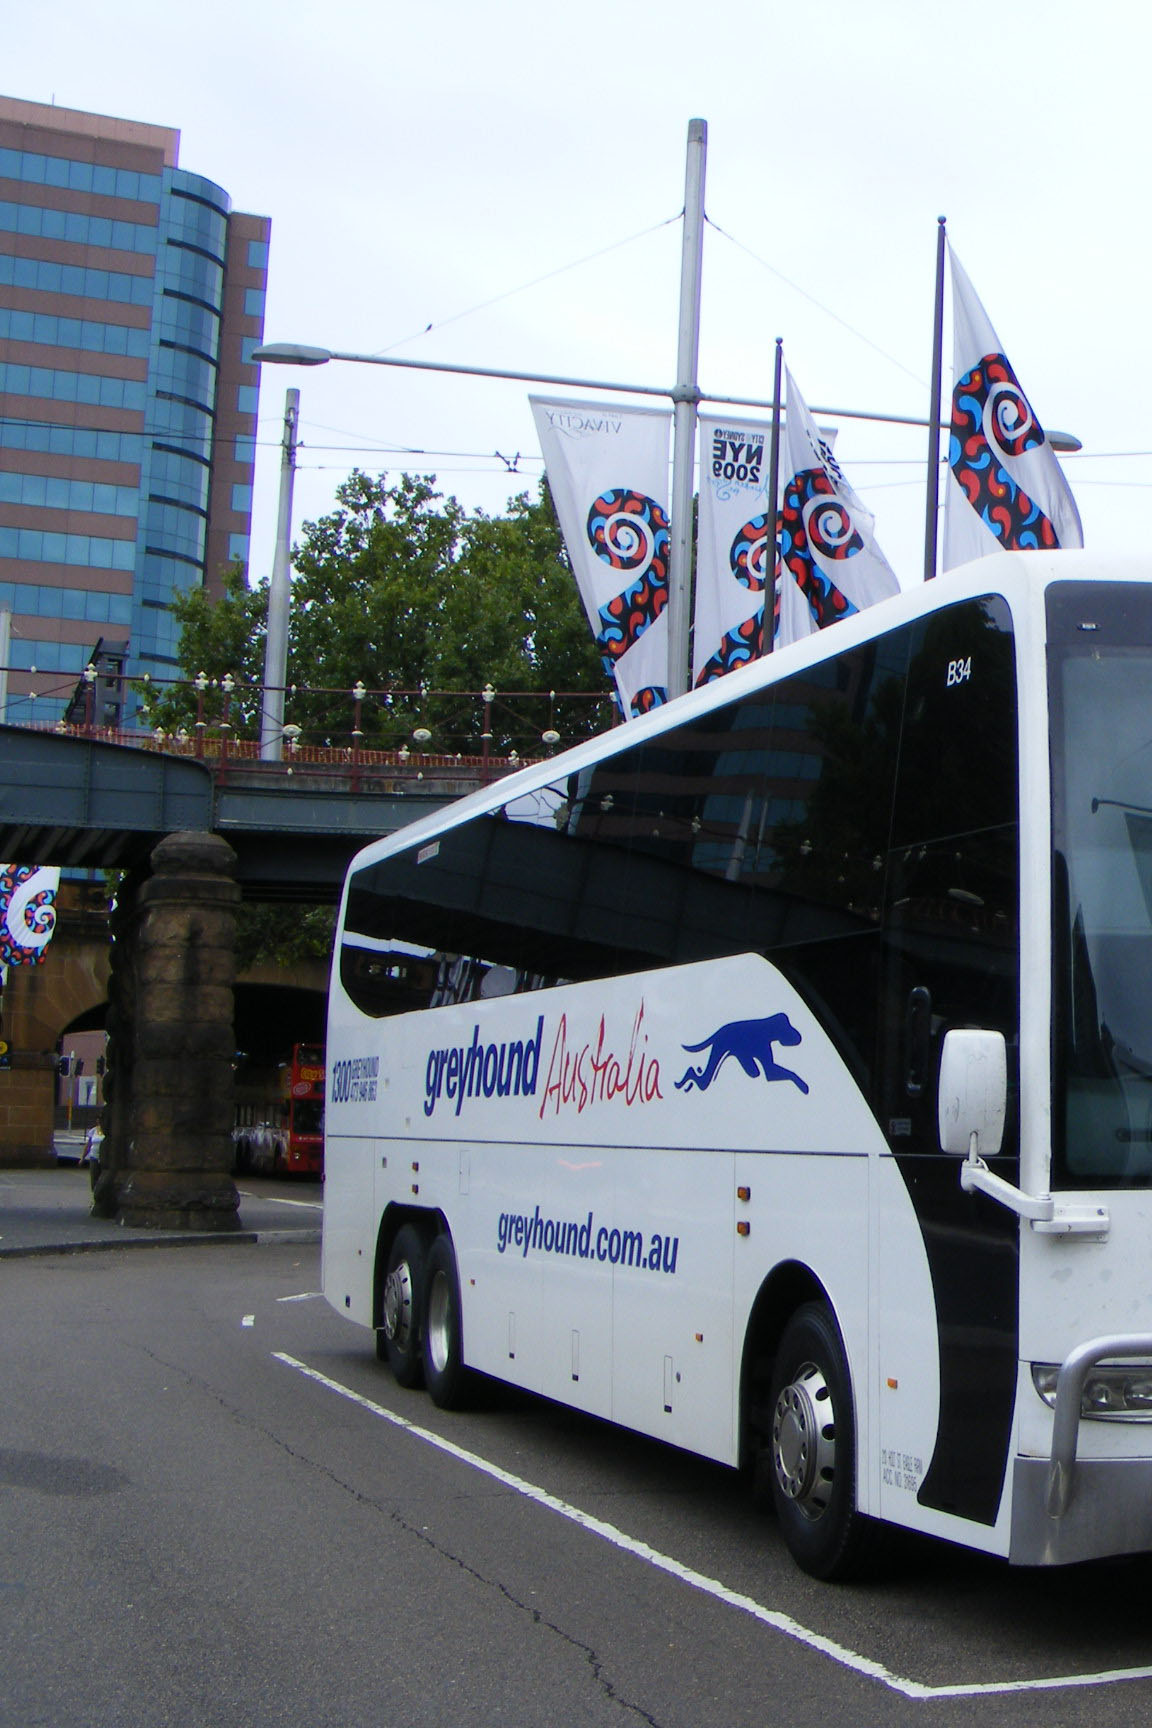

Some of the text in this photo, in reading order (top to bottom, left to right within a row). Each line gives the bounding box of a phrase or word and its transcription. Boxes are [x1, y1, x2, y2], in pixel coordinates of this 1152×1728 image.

[946, 656, 971, 687] B34
[332, 1060, 351, 1103] 1300
[424, 997, 663, 1120] greyhound Australia
[497, 1205, 679, 1274] greyhound.com.au
